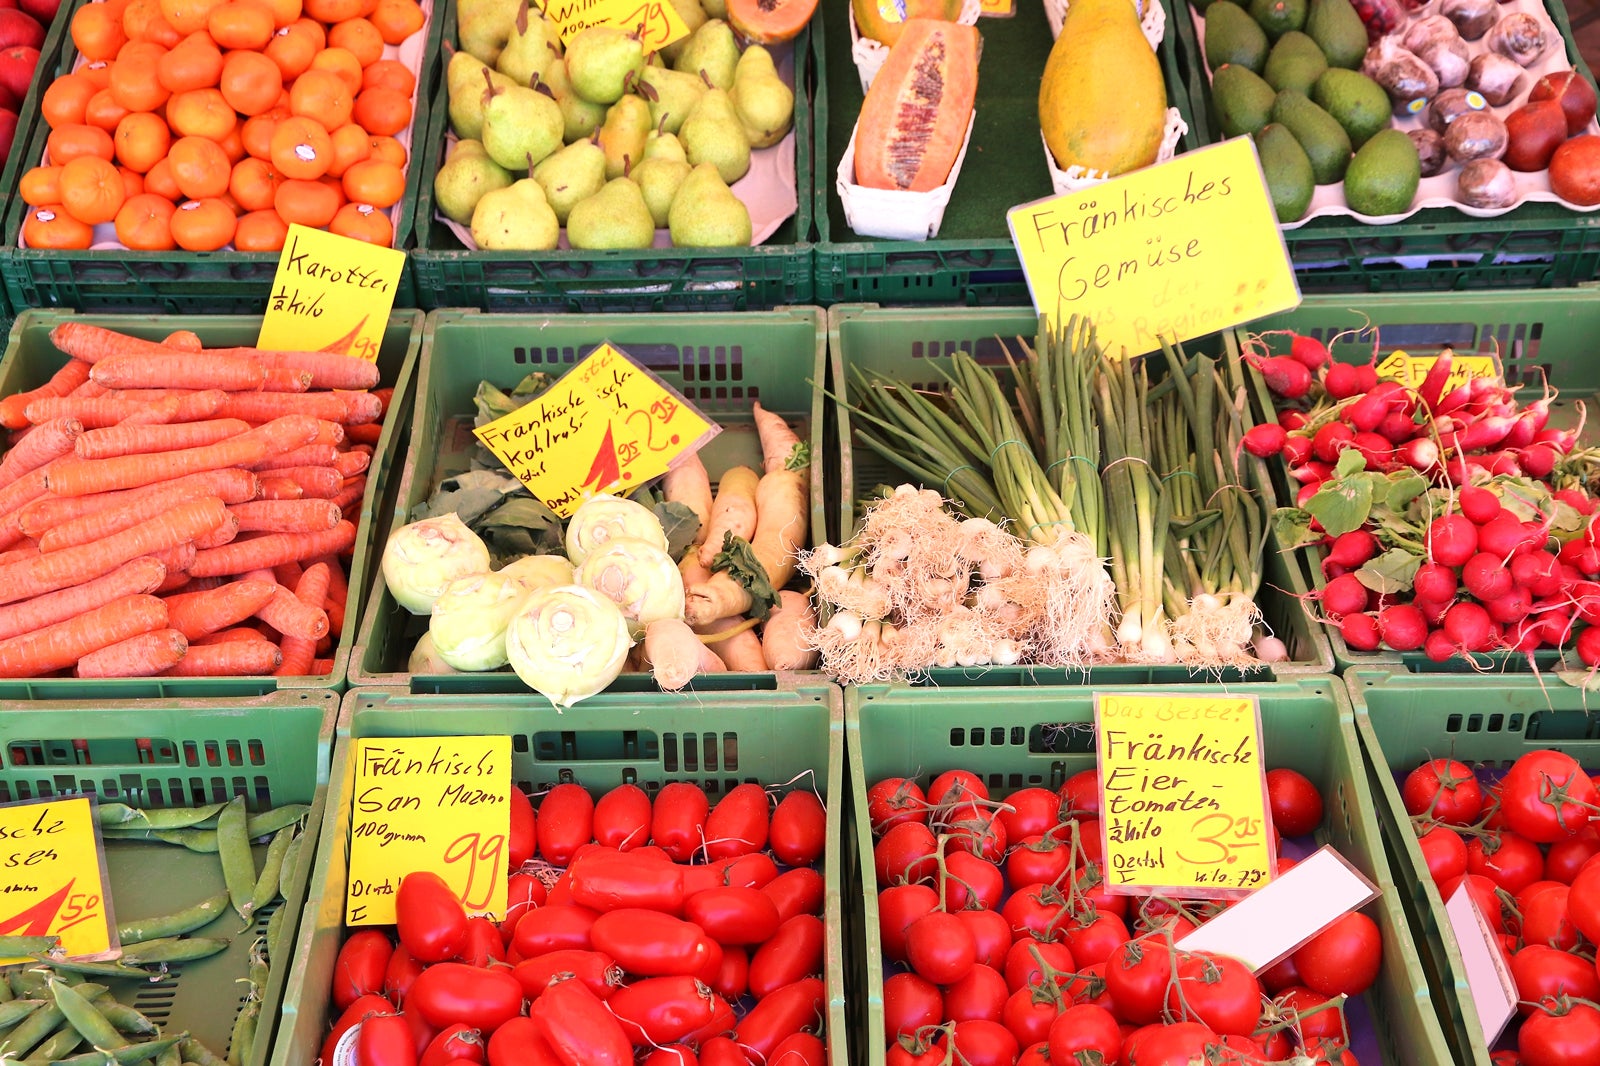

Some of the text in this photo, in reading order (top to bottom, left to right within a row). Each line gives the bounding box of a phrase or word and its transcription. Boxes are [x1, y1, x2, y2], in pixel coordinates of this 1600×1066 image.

[1032, 171, 1232, 252] Fränkisches
[1058, 235, 1202, 301] Gemüse
[481, 389, 586, 448] Fränkische
[1104, 697, 1248, 722] Das Beste!
[363, 745, 494, 778] Fränkische
[1106, 730, 1252, 764] Fränkische
[358, 786, 421, 813] San
[1109, 790, 1220, 814] tomaten
[443, 832, 506, 910] 99
